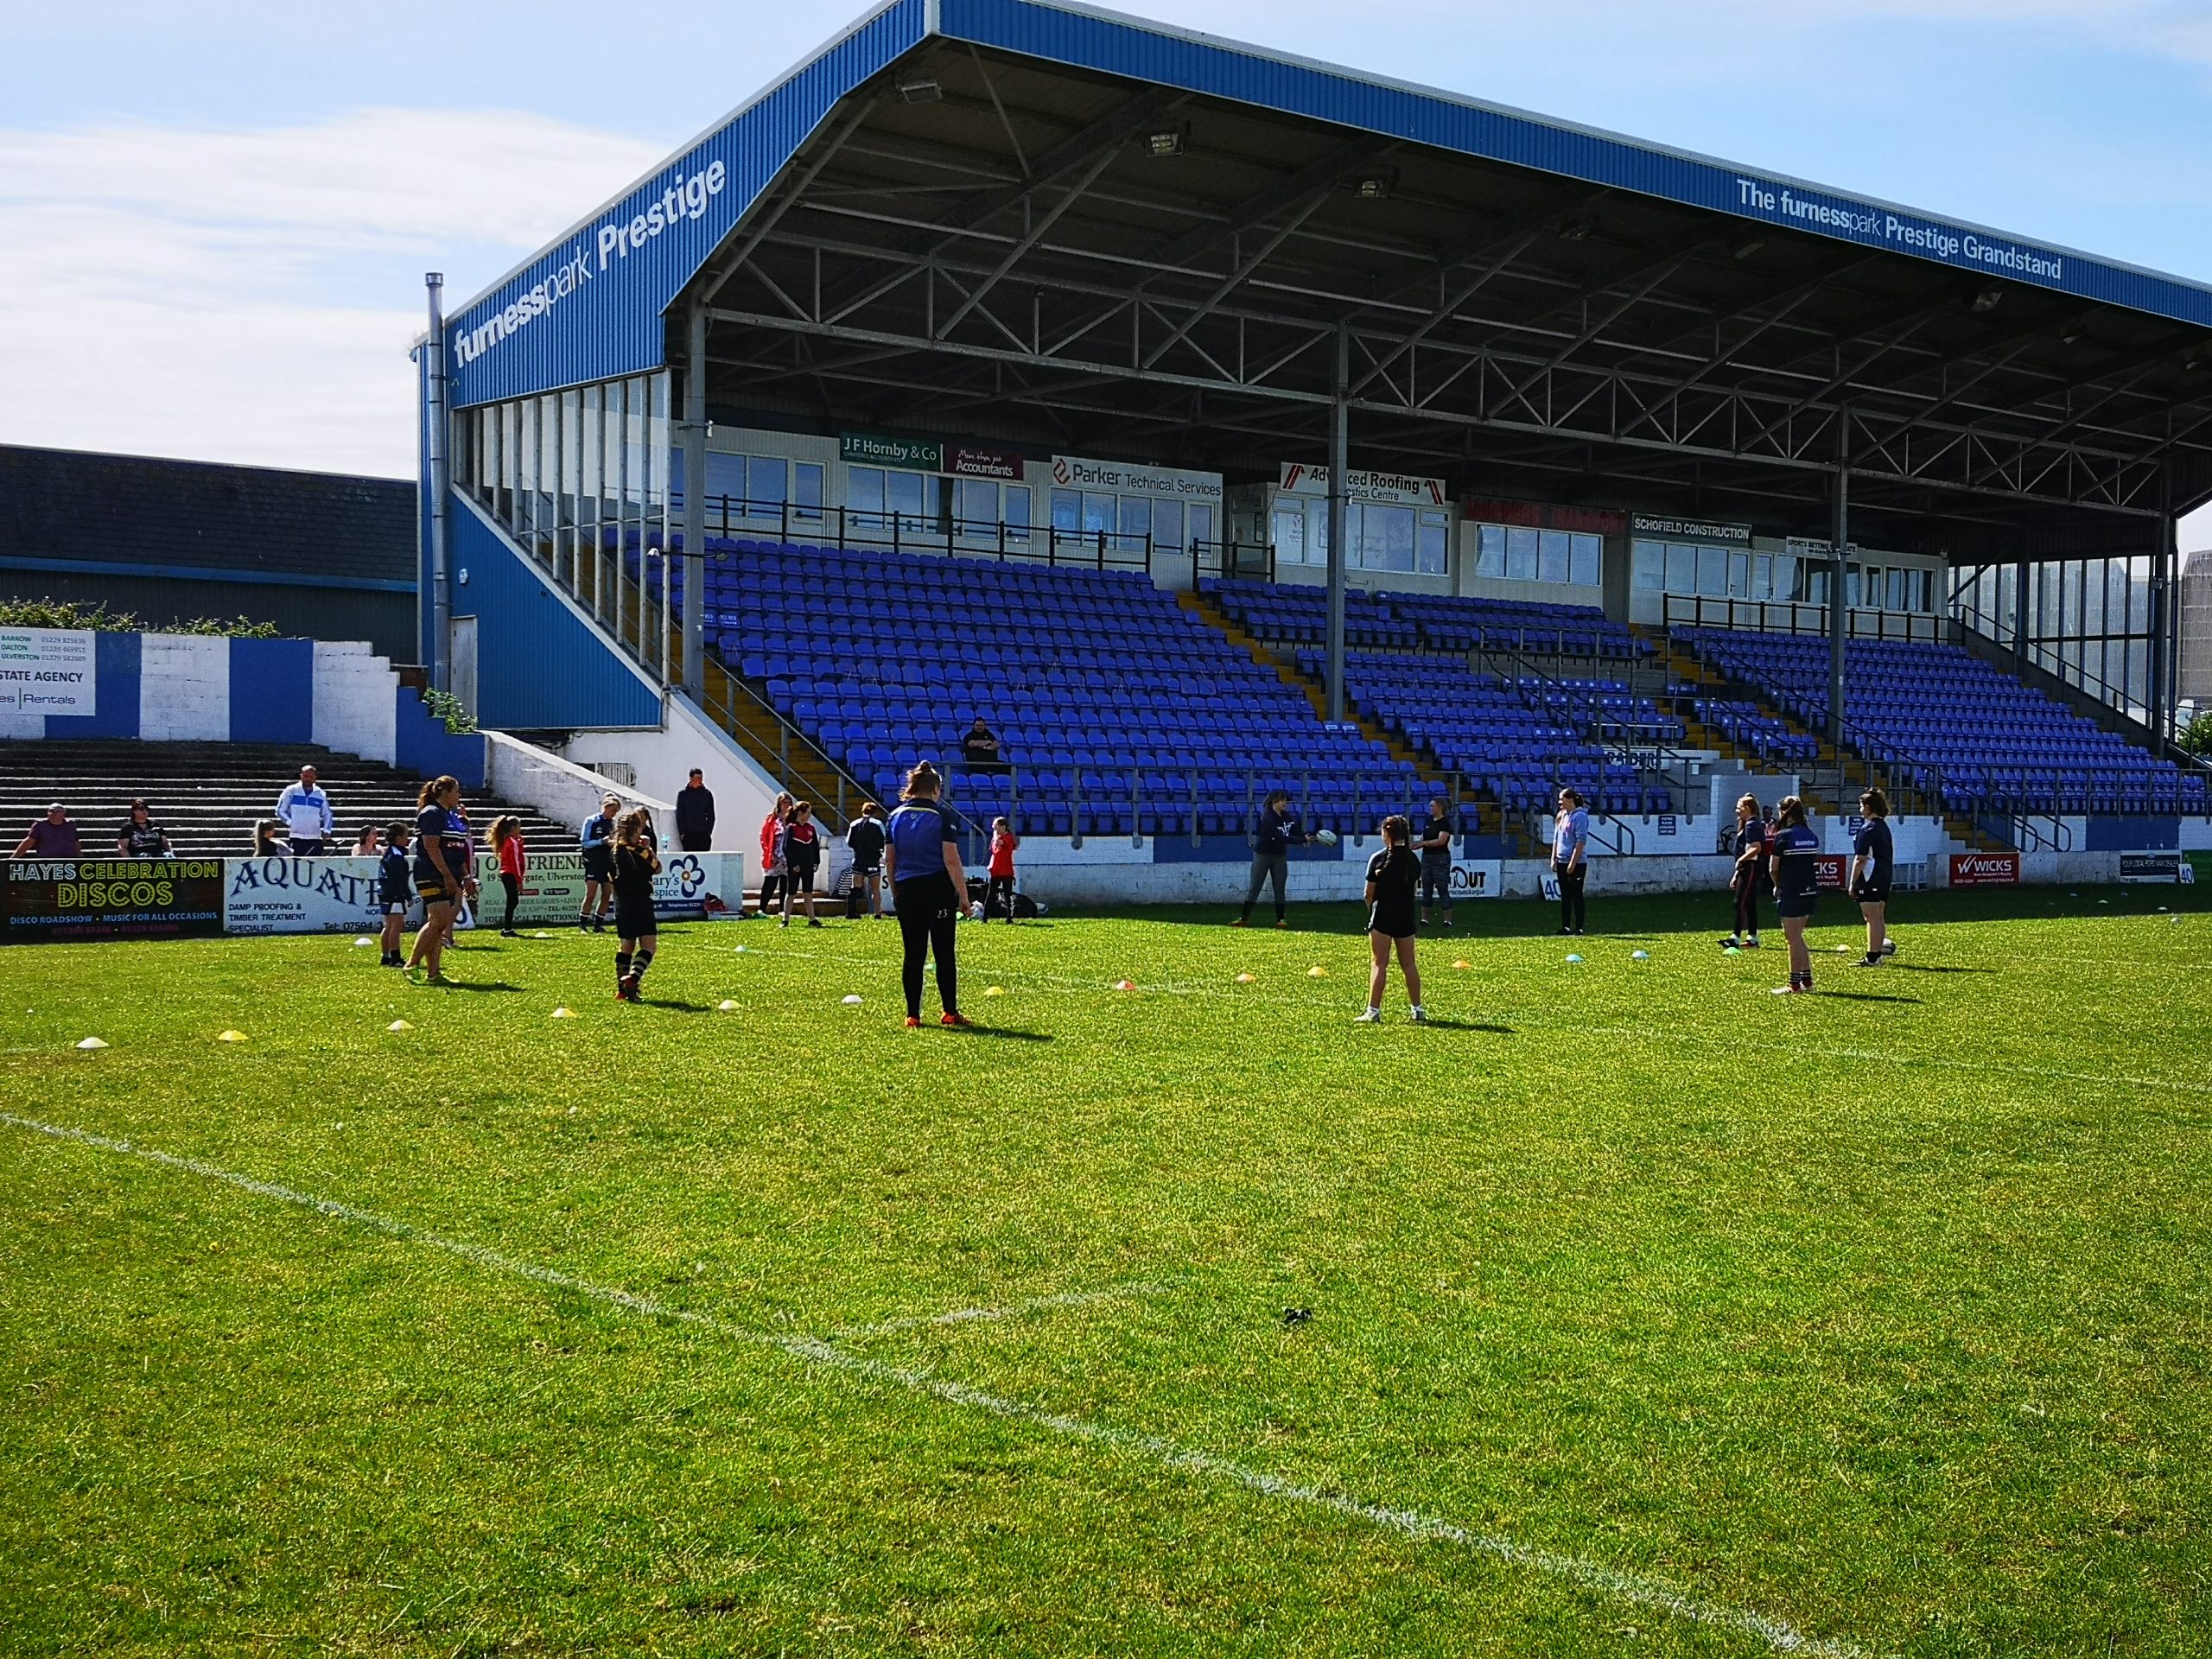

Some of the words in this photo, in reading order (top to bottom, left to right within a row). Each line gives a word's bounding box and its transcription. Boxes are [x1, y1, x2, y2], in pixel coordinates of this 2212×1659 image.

[1737, 179, 1776, 210] The
[1781, 190, 1881, 237] furnesspark
[1885, 216, 1958, 257] Prestige
[1963, 235, 2062, 280] Grandstand
[454, 245, 593, 368] furnesspark
[598, 160, 725, 270] Prestige
[844, 438, 850, 450] J
[854, 439, 861, 451] F
[864, 440, 907, 460] Hornby
[911, 446, 919, 459] &
[922, 448, 937, 461] Co
[958, 449, 976, 460] More
[956, 460, 1014, 476] Accountants
[1073, 464, 1121, 486] Parker
[1125, 474, 1174, 492] Technical
[1178, 480, 1221, 496] Services
[1370, 473, 1420, 495] Roofing
[1371, 488, 1400, 501] Centre
[1634, 518, 1682, 533] SCHOFIELD
[1683, 524, 1750, 540] CONSTRUCTION
[0, 671, 31, 681] STATE
[34, 671, 83, 683] AGENCY
[22, 694, 76, 704] Rentals
[9, 863, 77, 880] HAYES
[79, 861, 219, 880] CELEBRATION
[1974, 860, 2012, 872] WICKS
[652, 874, 680, 887] ary's
[2182, 868, 2193, 882] 40
[57, 880, 175, 907] DISCOS
[652, 888, 679, 899] spice
[10, 916, 38, 925] DISCO
[40, 915, 92, 925] ROADSHOW
[103, 913, 130, 922] MUSIC
[132, 913, 150, 922] FOR
[150, 912, 167, 921] ALL
[168, 912, 218, 920] OCCASIONS
[937, 909, 948, 918] 23
[324, 922, 338, 931] Tel:
[343, 922, 373, 931] 07594
